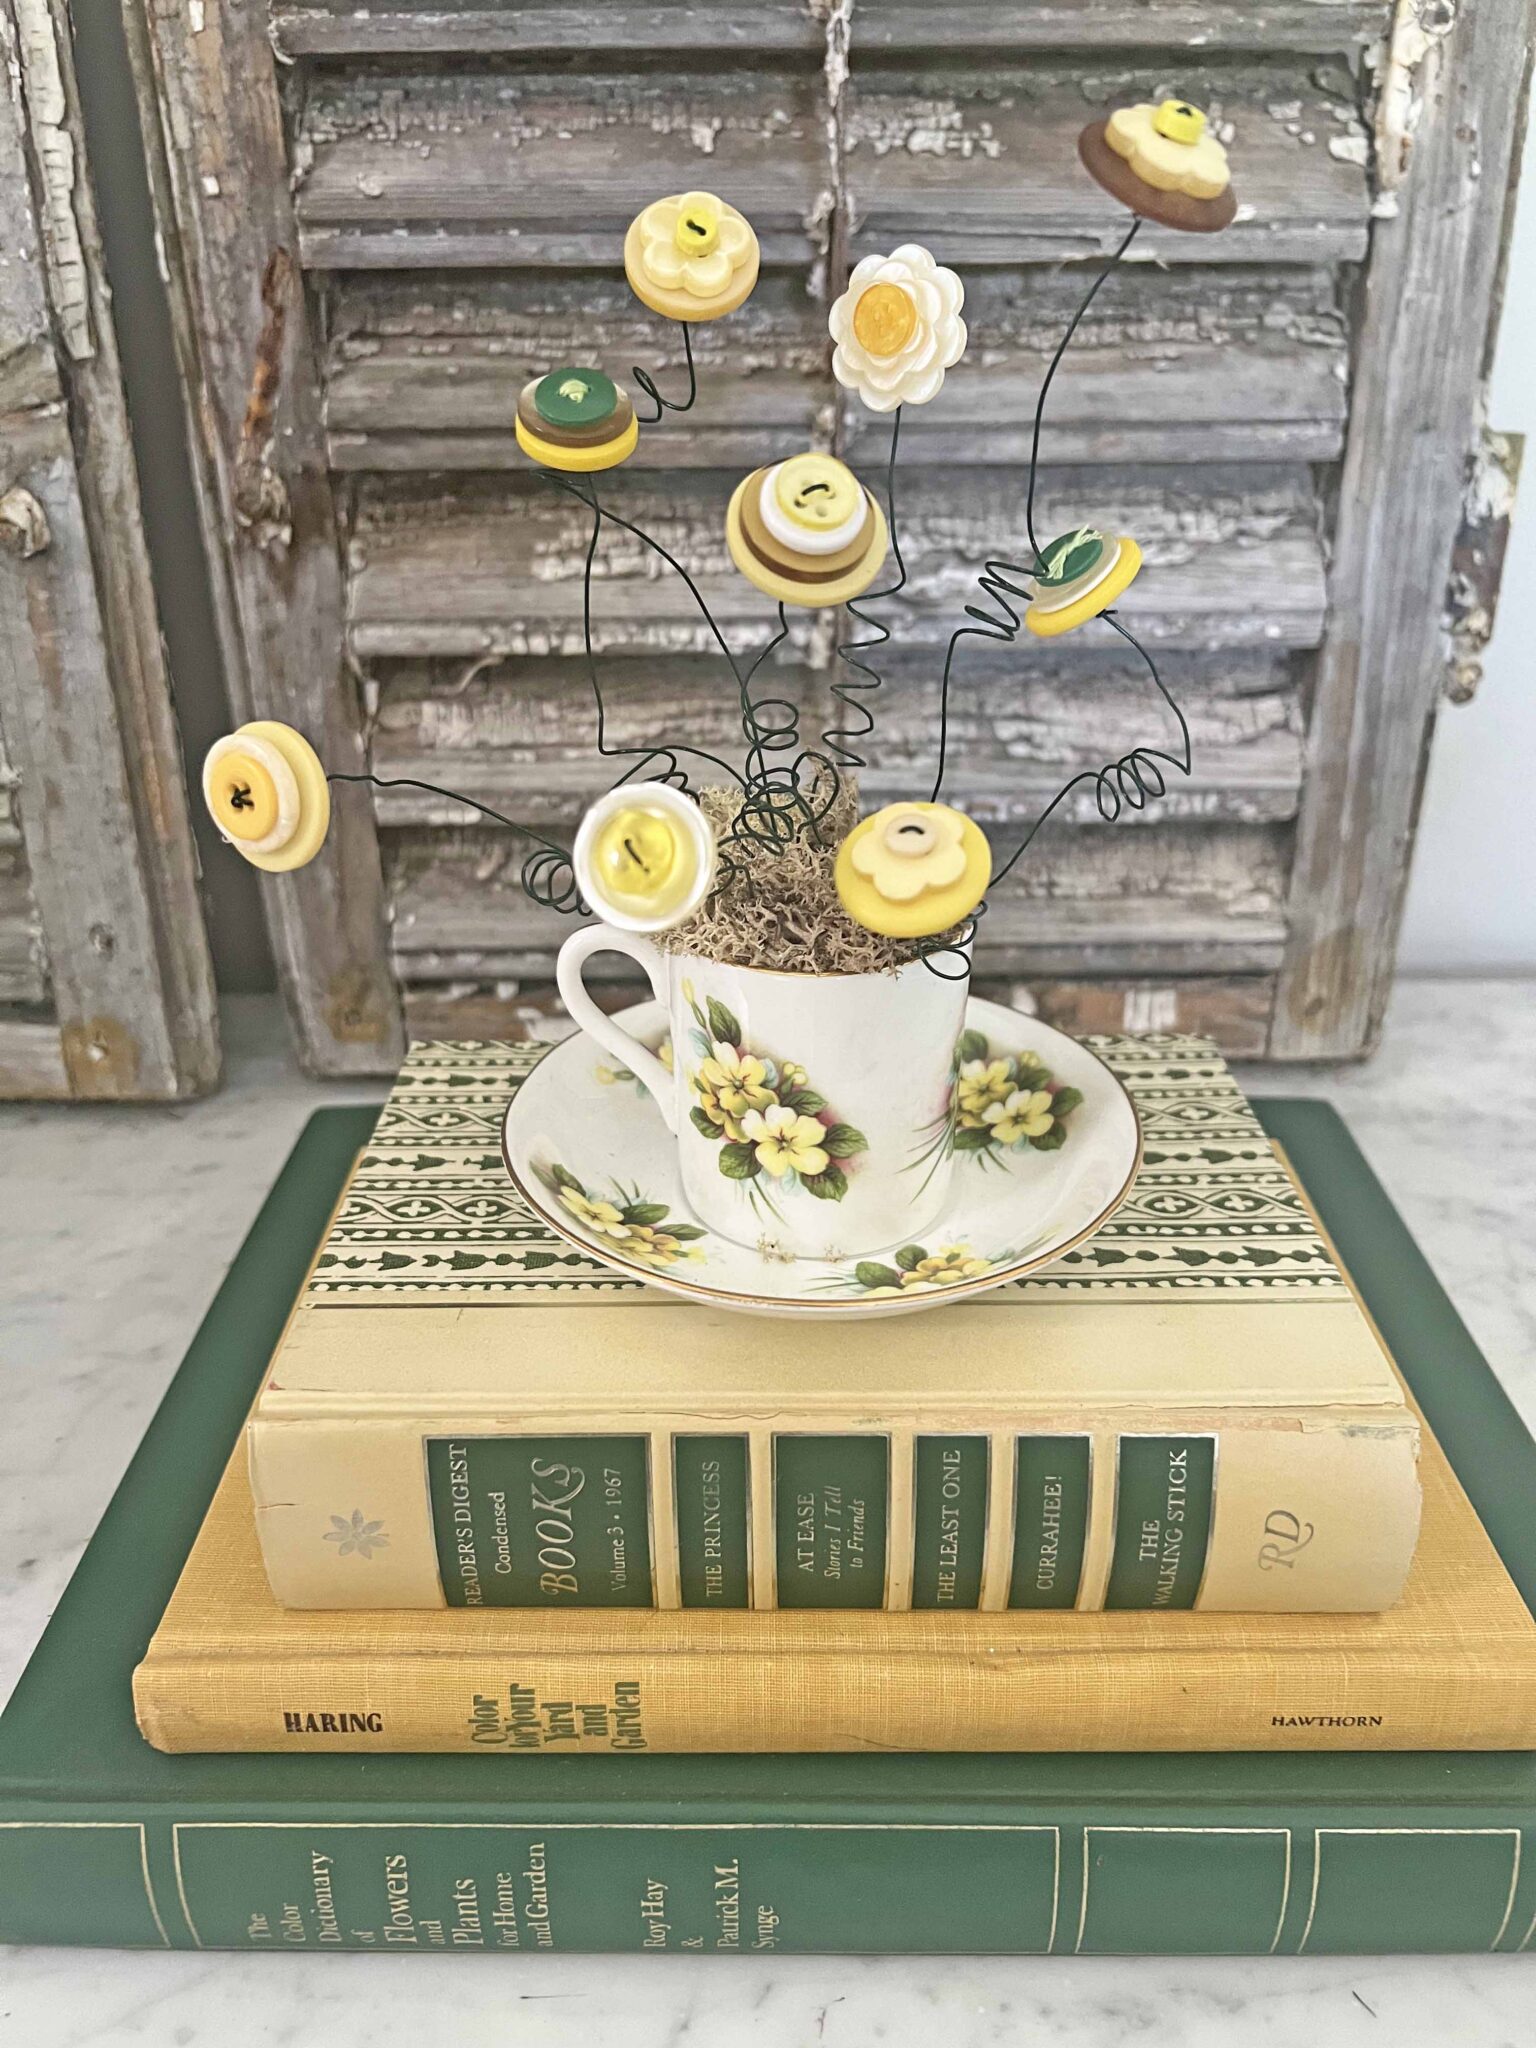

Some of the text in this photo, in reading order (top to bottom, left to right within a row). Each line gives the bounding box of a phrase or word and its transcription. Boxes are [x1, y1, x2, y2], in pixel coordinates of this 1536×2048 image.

[449, 1443, 484, 1605] READER'S DIGEST
[488, 1491, 512, 1574] Condensed
[531, 1457, 586, 1596] BOOKS
[604, 1467, 627, 1591] Volume 3 1967
[702, 1460, 723, 1598] THE PRINCESS
[797, 1492, 815, 1573] AT EASE
[823, 1485, 842, 1580] Stories I Tell
[847, 1498, 866, 1569] to Friends
[937, 1449, 961, 1603] THE LEAST ONE
[1036, 1475, 1063, 1591] CURRAHEE!
[1139, 1519, 1160, 1562] THE
[1152, 1448, 1188, 1607] WALKING STICK
[1258, 1508, 1314, 1572] RD
[283, 1711, 383, 1733] HARING
[468, 1694, 508, 1743] Color
[540, 1702, 580, 1743] Yard
[575, 1704, 608, 1736] and
[608, 1681, 648, 1749] Garden
[1271, 1716, 1383, 1727] HAWTHORN
[248, 1912, 272, 1938] The
[280, 1902, 306, 1942] Color
[310, 1849, 342, 1942] Dictionary
[383, 1855, 418, 1943] Flowers
[451, 1878, 484, 1945] Plants
[493, 1872, 516, 1927] Home
[523, 1842, 554, 1947] and Garden
[640, 1877, 672, 1947] Roy Hay
[714, 1858, 740, 1948] Patrick M.
[751, 1905, 781, 1949] Synge
[350, 1928, 376, 1943] of
[419, 1919, 446, 1945] and
[681, 1936, 704, 1948] &
